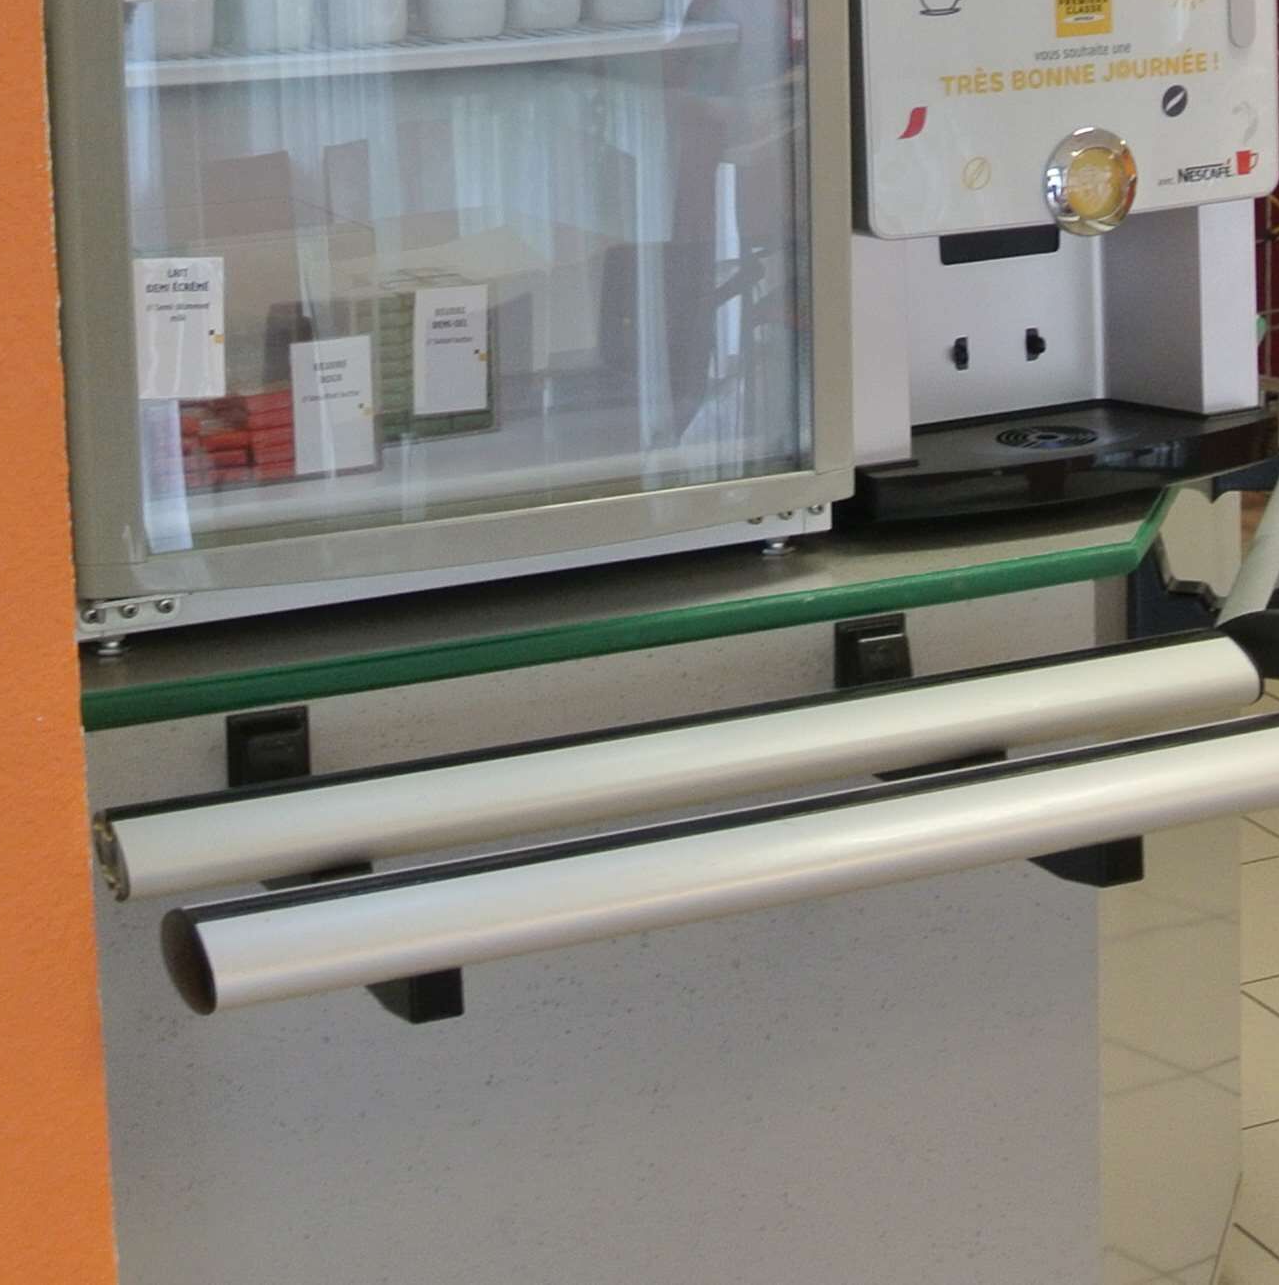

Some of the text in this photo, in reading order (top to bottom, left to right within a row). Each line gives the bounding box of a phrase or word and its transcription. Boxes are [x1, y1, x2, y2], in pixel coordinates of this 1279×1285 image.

[1035, 43, 1132, 60] vous souhaite une
[940, 68, 1005, 97] TRÈS
[1011, 63, 1096, 92] BONNE
[1103, 48, 1209, 84] JOURNÉE
